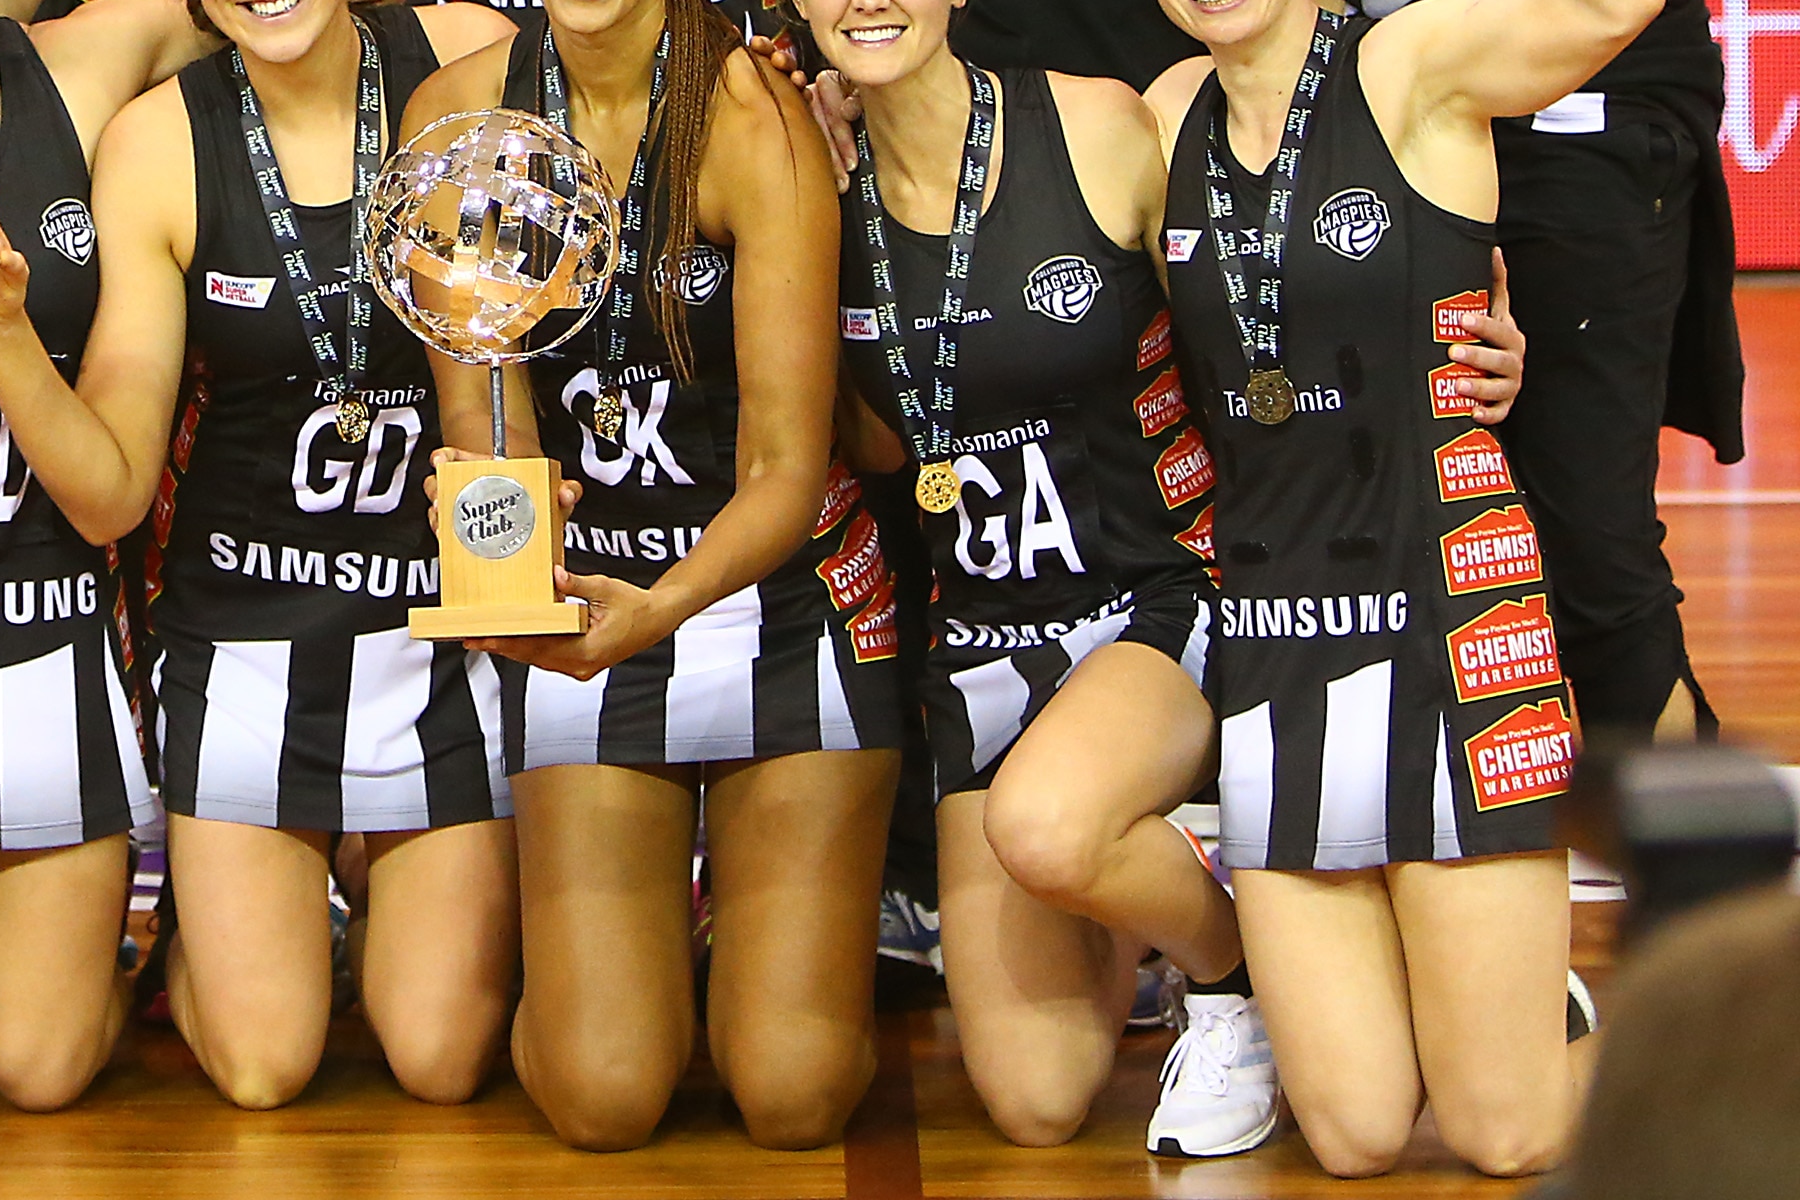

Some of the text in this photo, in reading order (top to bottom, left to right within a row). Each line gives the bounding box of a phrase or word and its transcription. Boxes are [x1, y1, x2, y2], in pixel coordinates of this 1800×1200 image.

[1309, 70, 1325, 100] Super
[1296, 108, 1311, 139] Super
[255, 125, 271, 157] Super
[960, 156, 974, 191] Super
[1319, 202, 1384, 235] MAGPIES
[1325, 194, 1370, 213] COLLINGWOOD
[46, 212, 93, 239] MAGPIES
[293, 249, 311, 282] Super
[616, 240, 627, 275] Super
[1034, 260, 1080, 281] COLLINGWOOD
[1030, 267, 1095, 302] MAGPIES
[914, 307, 992, 330] DIARA
[940, 288, 952, 323] Super
[896, 346, 911, 379] Super
[314, 379, 426, 406] Taania
[1139, 383, 1184, 420] CHEM
[1223, 383, 1342, 418] Tania
[951, 418, 1051, 454] asmania
[292, 404, 422, 513] GD
[1162, 446, 1212, 488] CHEM
[1442, 451, 1504, 479] CHEMT
[459, 491, 523, 524] Super
[951, 441, 1087, 580] GA
[466, 513, 517, 545] Club
[564, 520, 703, 562] AMSU
[209, 531, 439, 598] SAMSUN
[1449, 532, 1535, 569] CHEMIST
[1453, 559, 1536, 584] WAREHOUSE
[1221, 590, 1409, 639] SAMSUNG
[1458, 627, 1553, 671] CHEMIST
[1464, 658, 1555, 689] WAREHOUSE
[1477, 730, 1573, 778] CHEMIST
